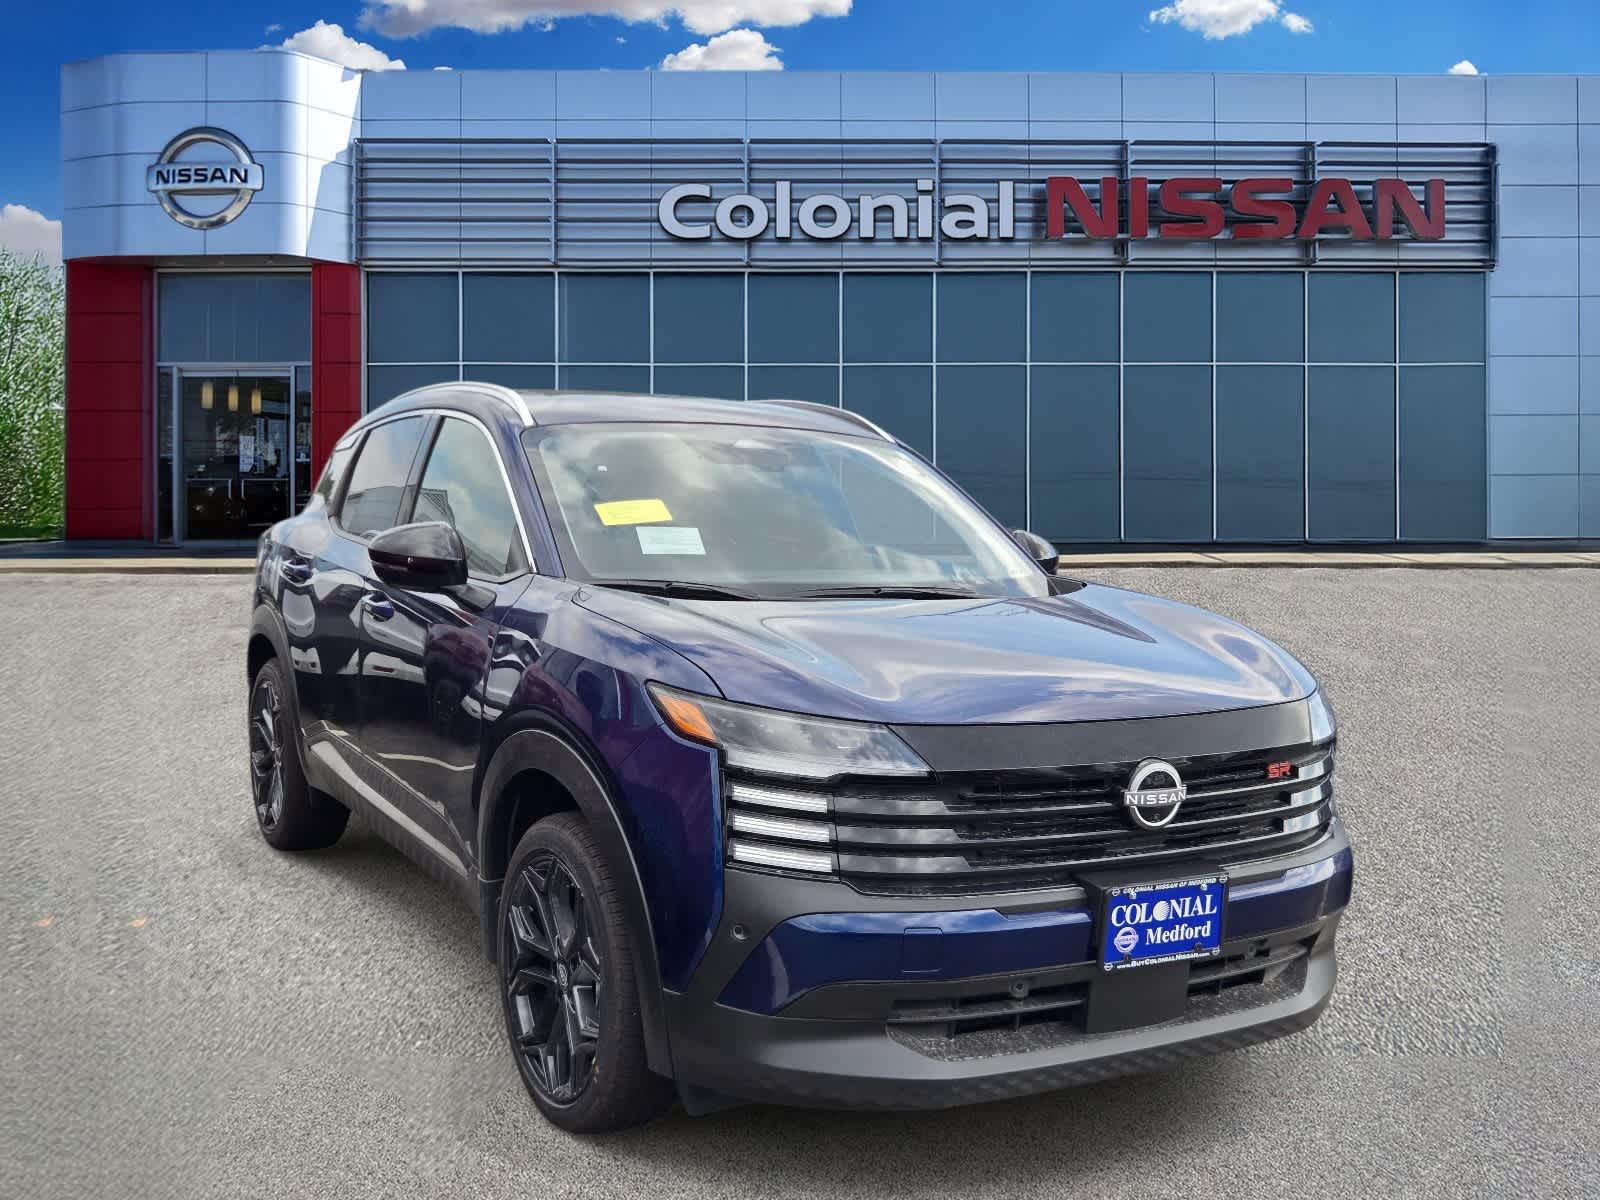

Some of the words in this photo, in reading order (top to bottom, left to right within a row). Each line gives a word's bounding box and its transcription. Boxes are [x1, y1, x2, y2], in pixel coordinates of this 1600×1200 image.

[155, 167, 249, 185] NISSAN
[657, 179, 1015, 240] Colonial
[1046, 176, 1446, 240] NISSAN
[1267, 761, 1291, 778] SR
[1126, 788, 1187, 806] NISSAN
[1111, 894, 1218, 927] COLONIAL
[1145, 920, 1212, 945] Medford
